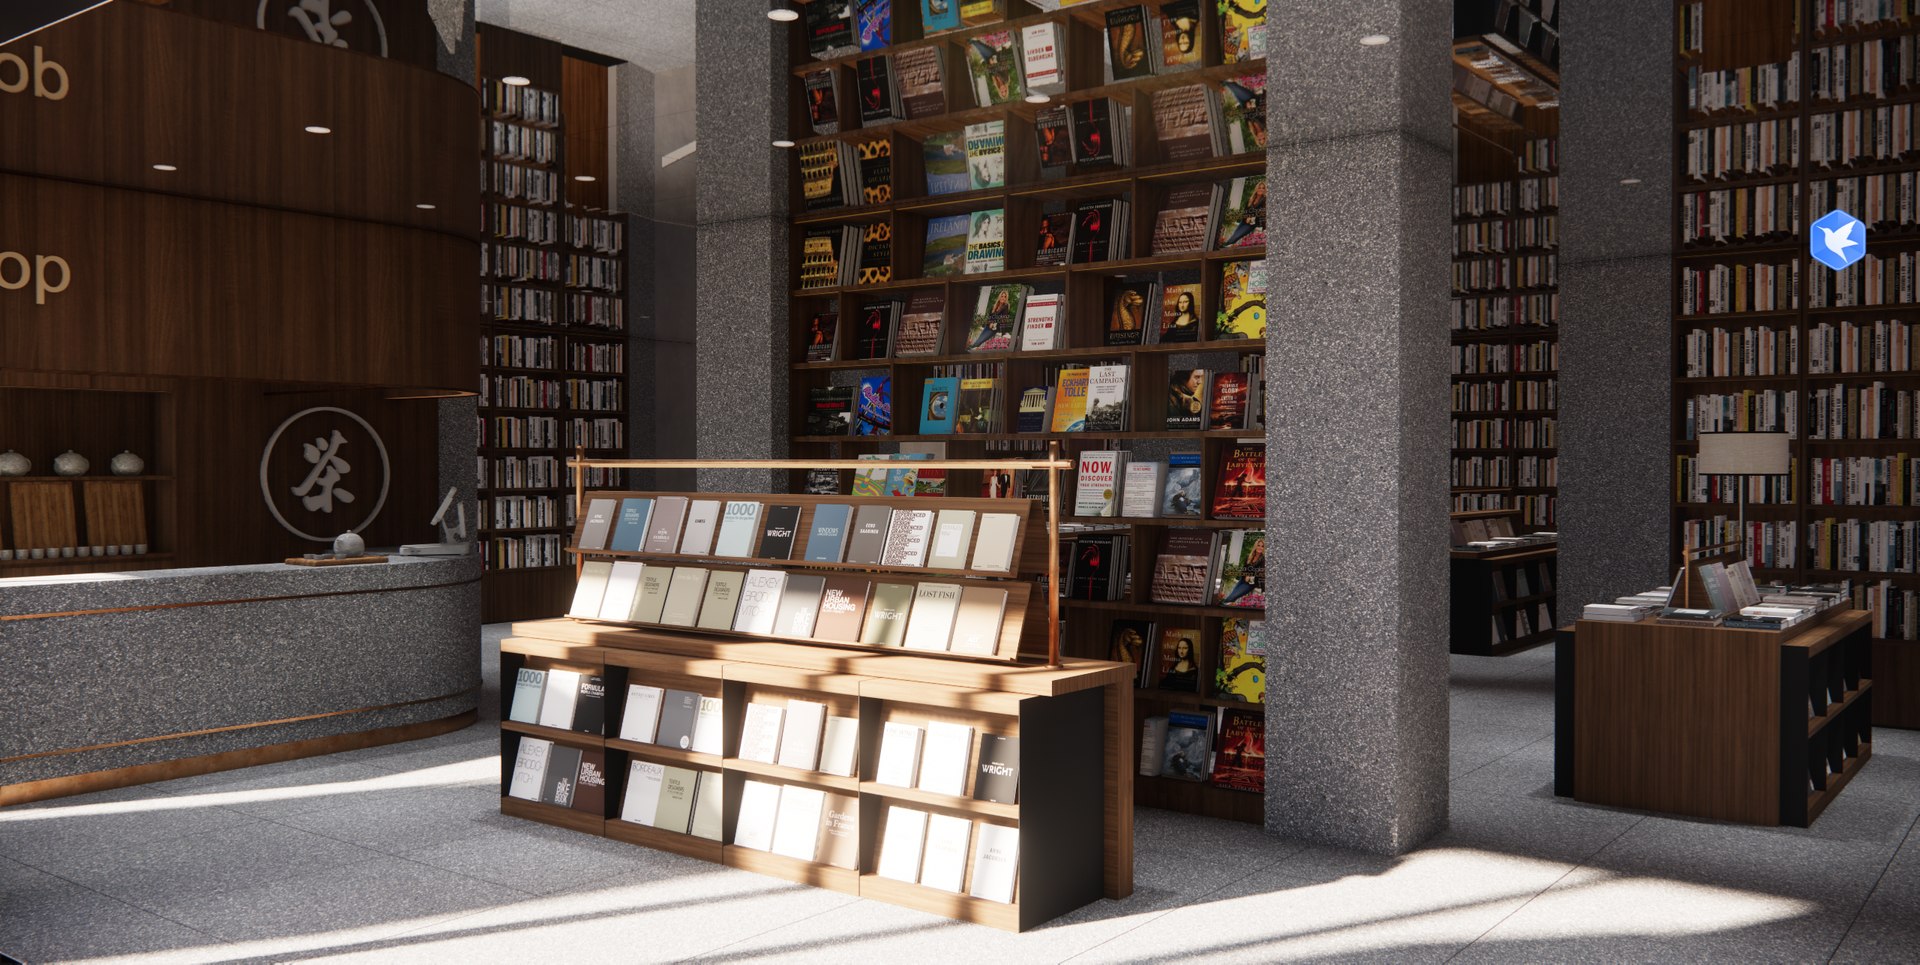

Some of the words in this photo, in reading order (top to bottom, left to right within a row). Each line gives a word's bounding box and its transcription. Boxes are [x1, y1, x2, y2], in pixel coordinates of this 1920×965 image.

[726, 503, 755, 516] 1000
[766, 529, 792, 538] WRIGHT
[826, 589, 844, 597] NEW
[919, 589, 938, 598] LOST
[938, 590, 956, 599] FISH
[824, 596, 850, 604] URBAN
[822, 602, 856, 612] HOUSING
[873, 611, 904, 620] WRIGHT
[519, 670, 543, 684] 1000
[581, 761, 596, 770] NEW
[632, 762, 663, 775] BORDEAUX
[981, 763, 1014, 777] WRIGHT
[580, 768, 602, 778] URBAN
[579, 773, 605, 785] HOUSING
